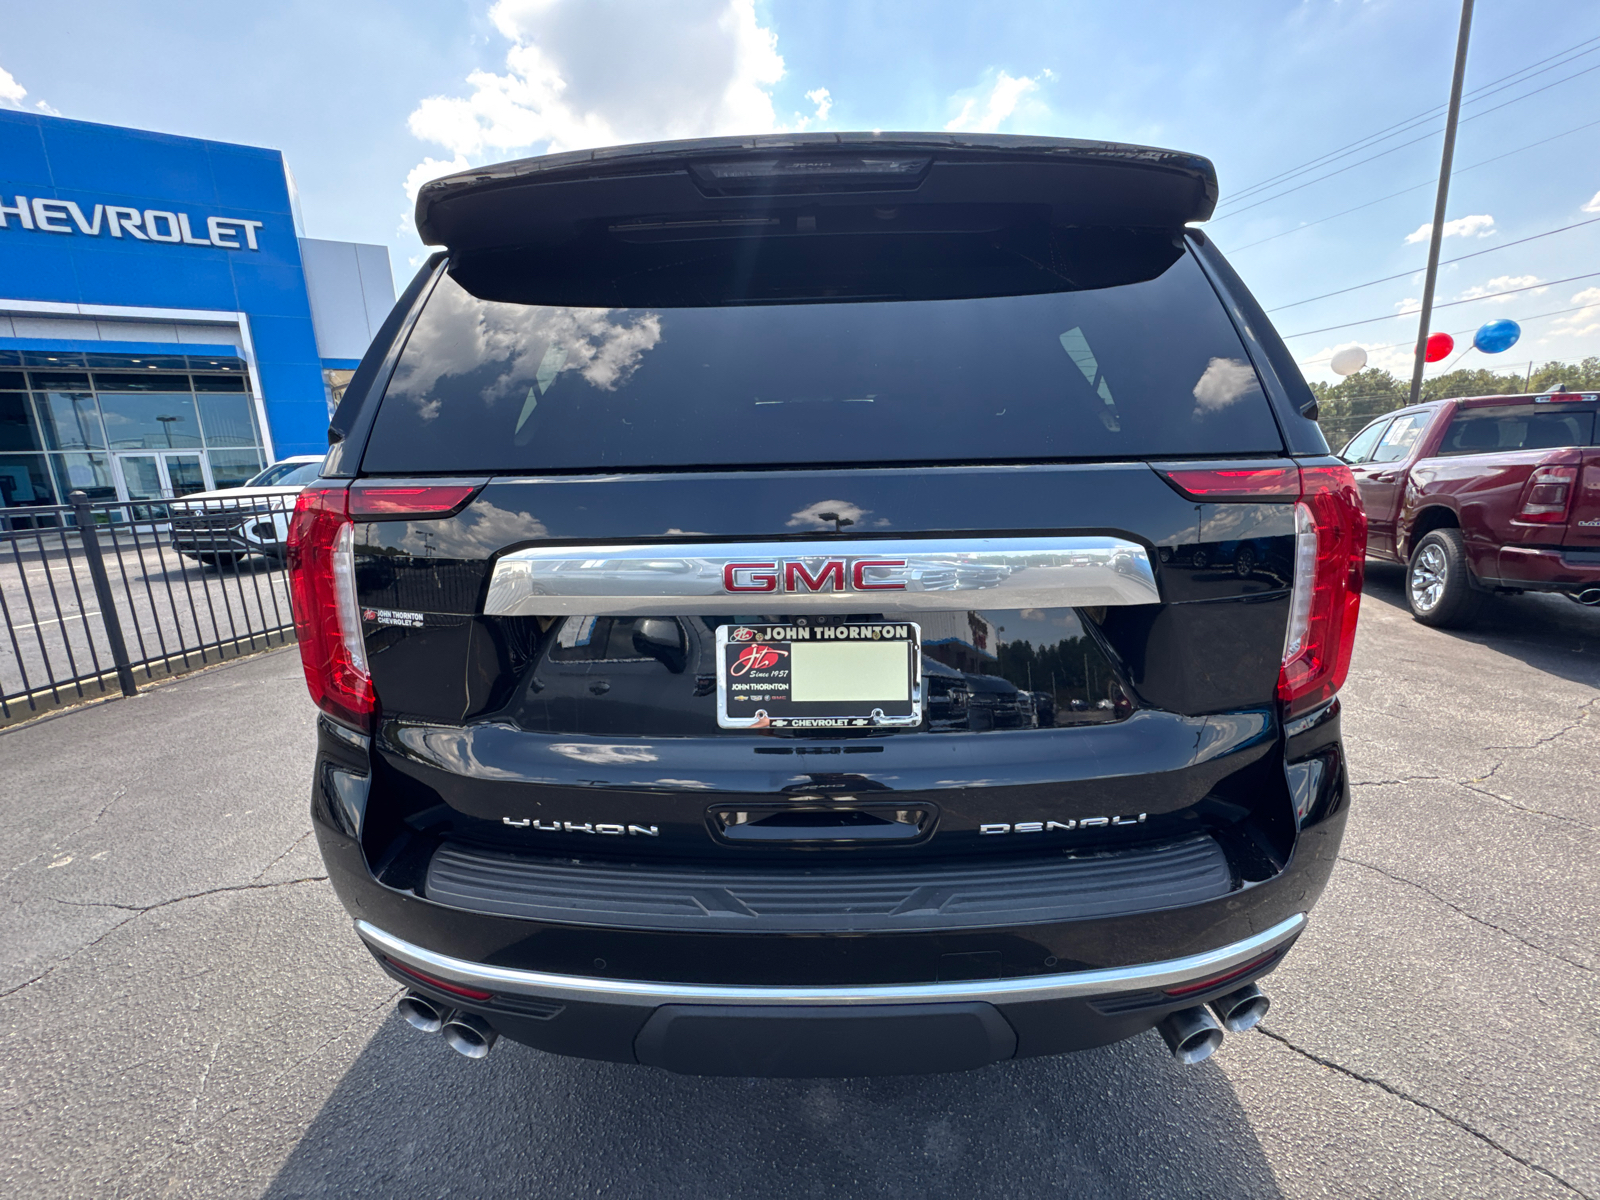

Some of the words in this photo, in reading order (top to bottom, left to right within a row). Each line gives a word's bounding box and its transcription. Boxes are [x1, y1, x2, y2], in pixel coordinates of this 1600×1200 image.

[722, 558, 909, 595] GMC
[377, 609, 392, 618] JOHN
[392, 611, 424, 621] THORNTON
[377, 616, 413, 627] CHEVROLET
[764, 626, 810, 640] JOHN
[814, 625, 908, 640] THORNTON
[749, 670, 769, 678] Since
[770, 670, 789, 678] 1957
[731, 683, 750, 691] JOHN
[750, 683, 789, 691] THORNTON
[791, 718, 849, 728] CHEVROLET
[502, 816, 660, 837] YUKON
[979, 812, 1147, 835] DENALI
